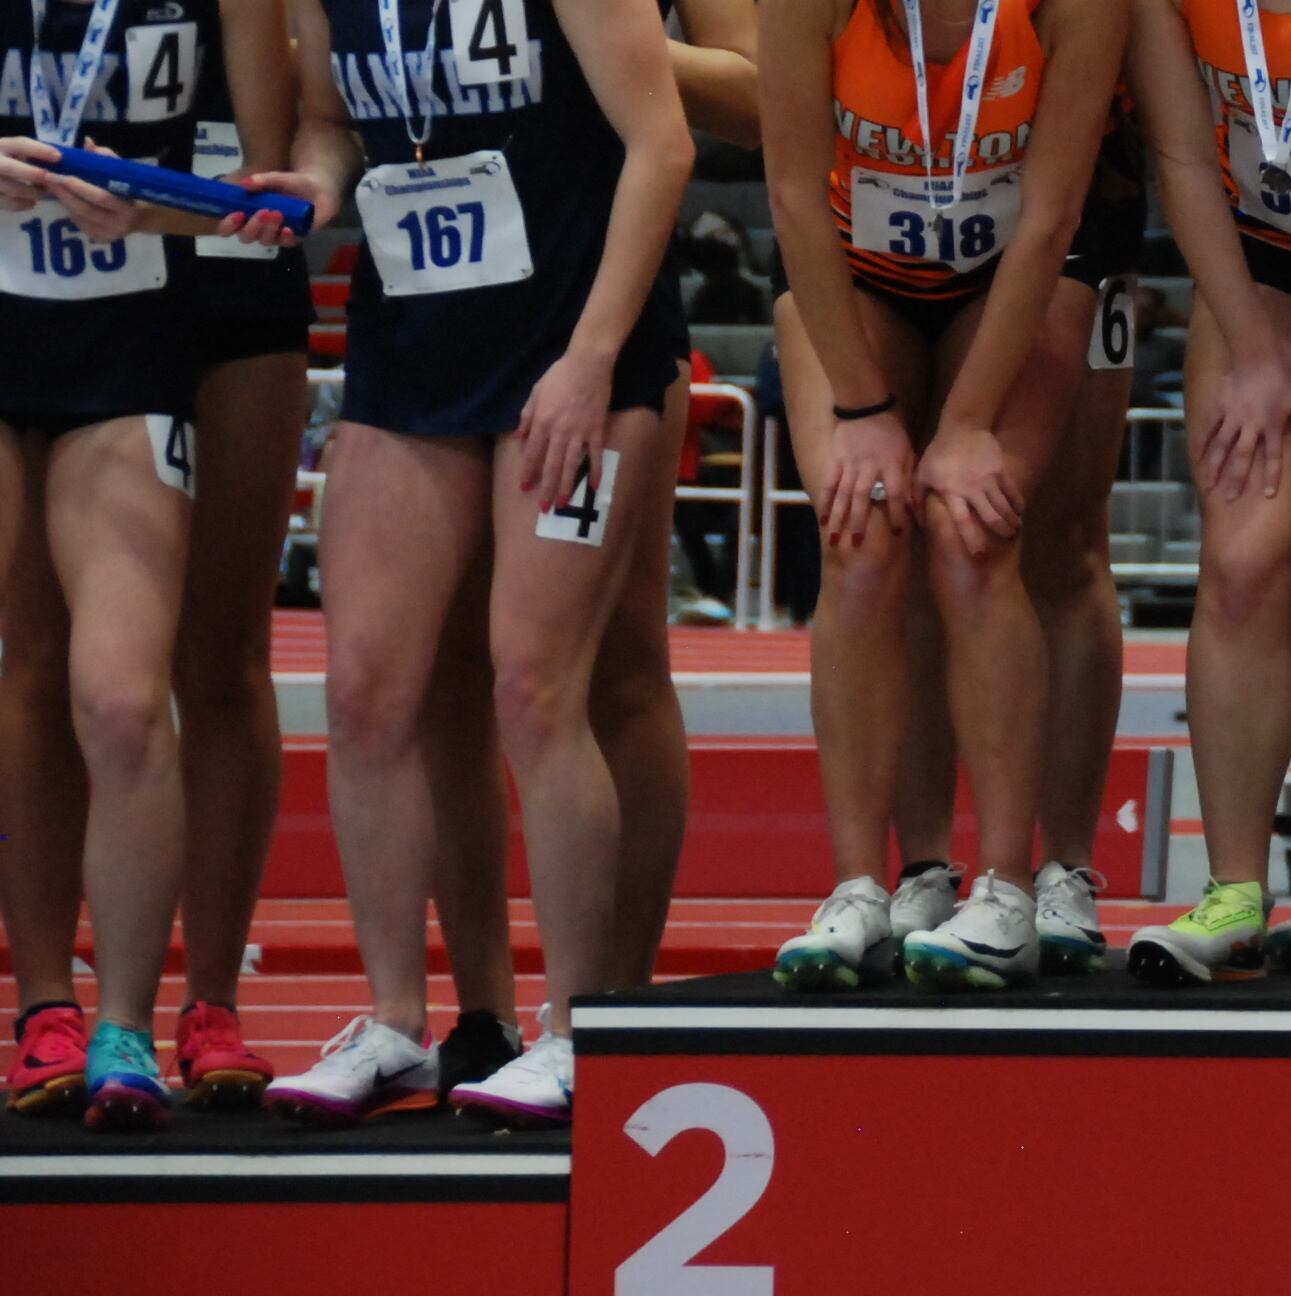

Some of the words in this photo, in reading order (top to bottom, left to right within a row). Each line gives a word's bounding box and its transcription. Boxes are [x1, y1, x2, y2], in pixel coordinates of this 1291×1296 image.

[142, 31, 184, 112] 4
[397, 201, 486, 271] 167
[888, 211, 996, 261] 318
[1102, 279, 1129, 365] 6
[165, 416, 191, 489] 4
[554, 452, 599, 539] 4
[614, 1081, 775, 1296] 2
